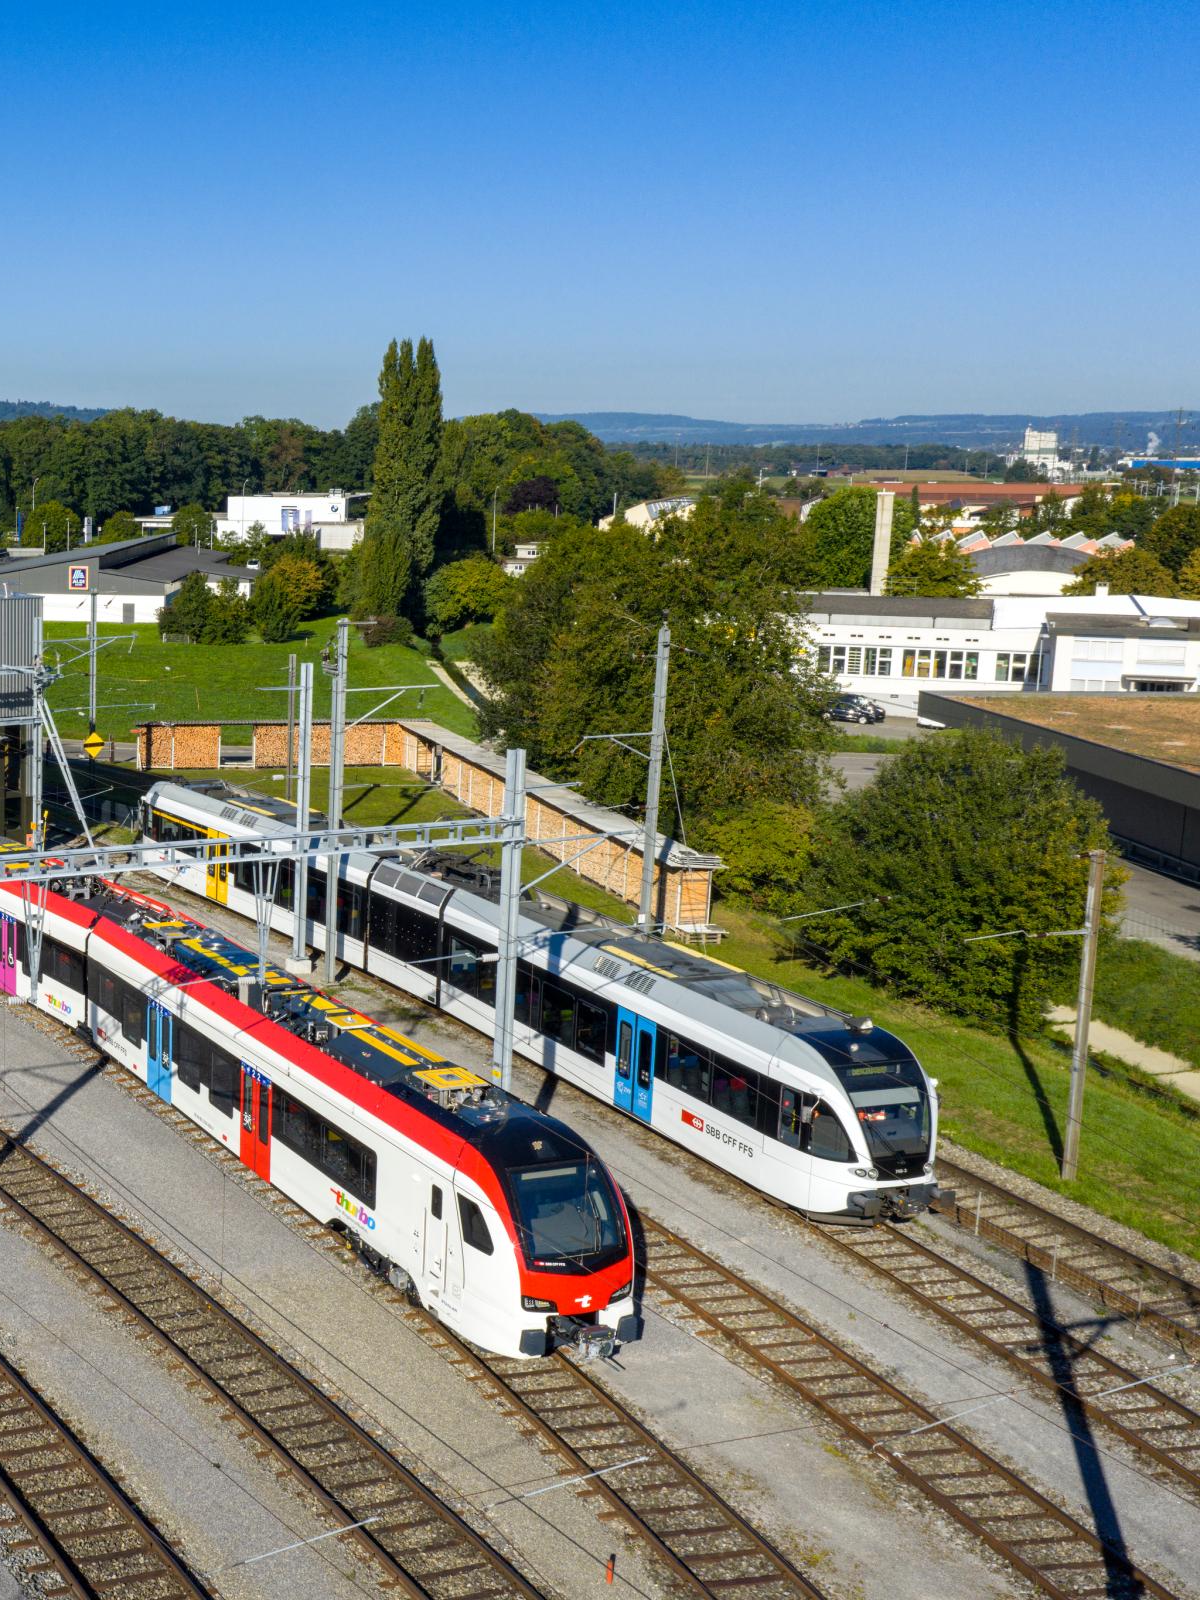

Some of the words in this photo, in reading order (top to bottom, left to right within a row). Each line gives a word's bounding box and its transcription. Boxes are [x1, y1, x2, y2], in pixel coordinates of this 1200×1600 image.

[705, 1124, 720, 1140] SBB
[722, 1133, 737, 1148] CFF
[738, 1142, 754, 1158] FFS
[330, 1188, 376, 1230] thurbo
